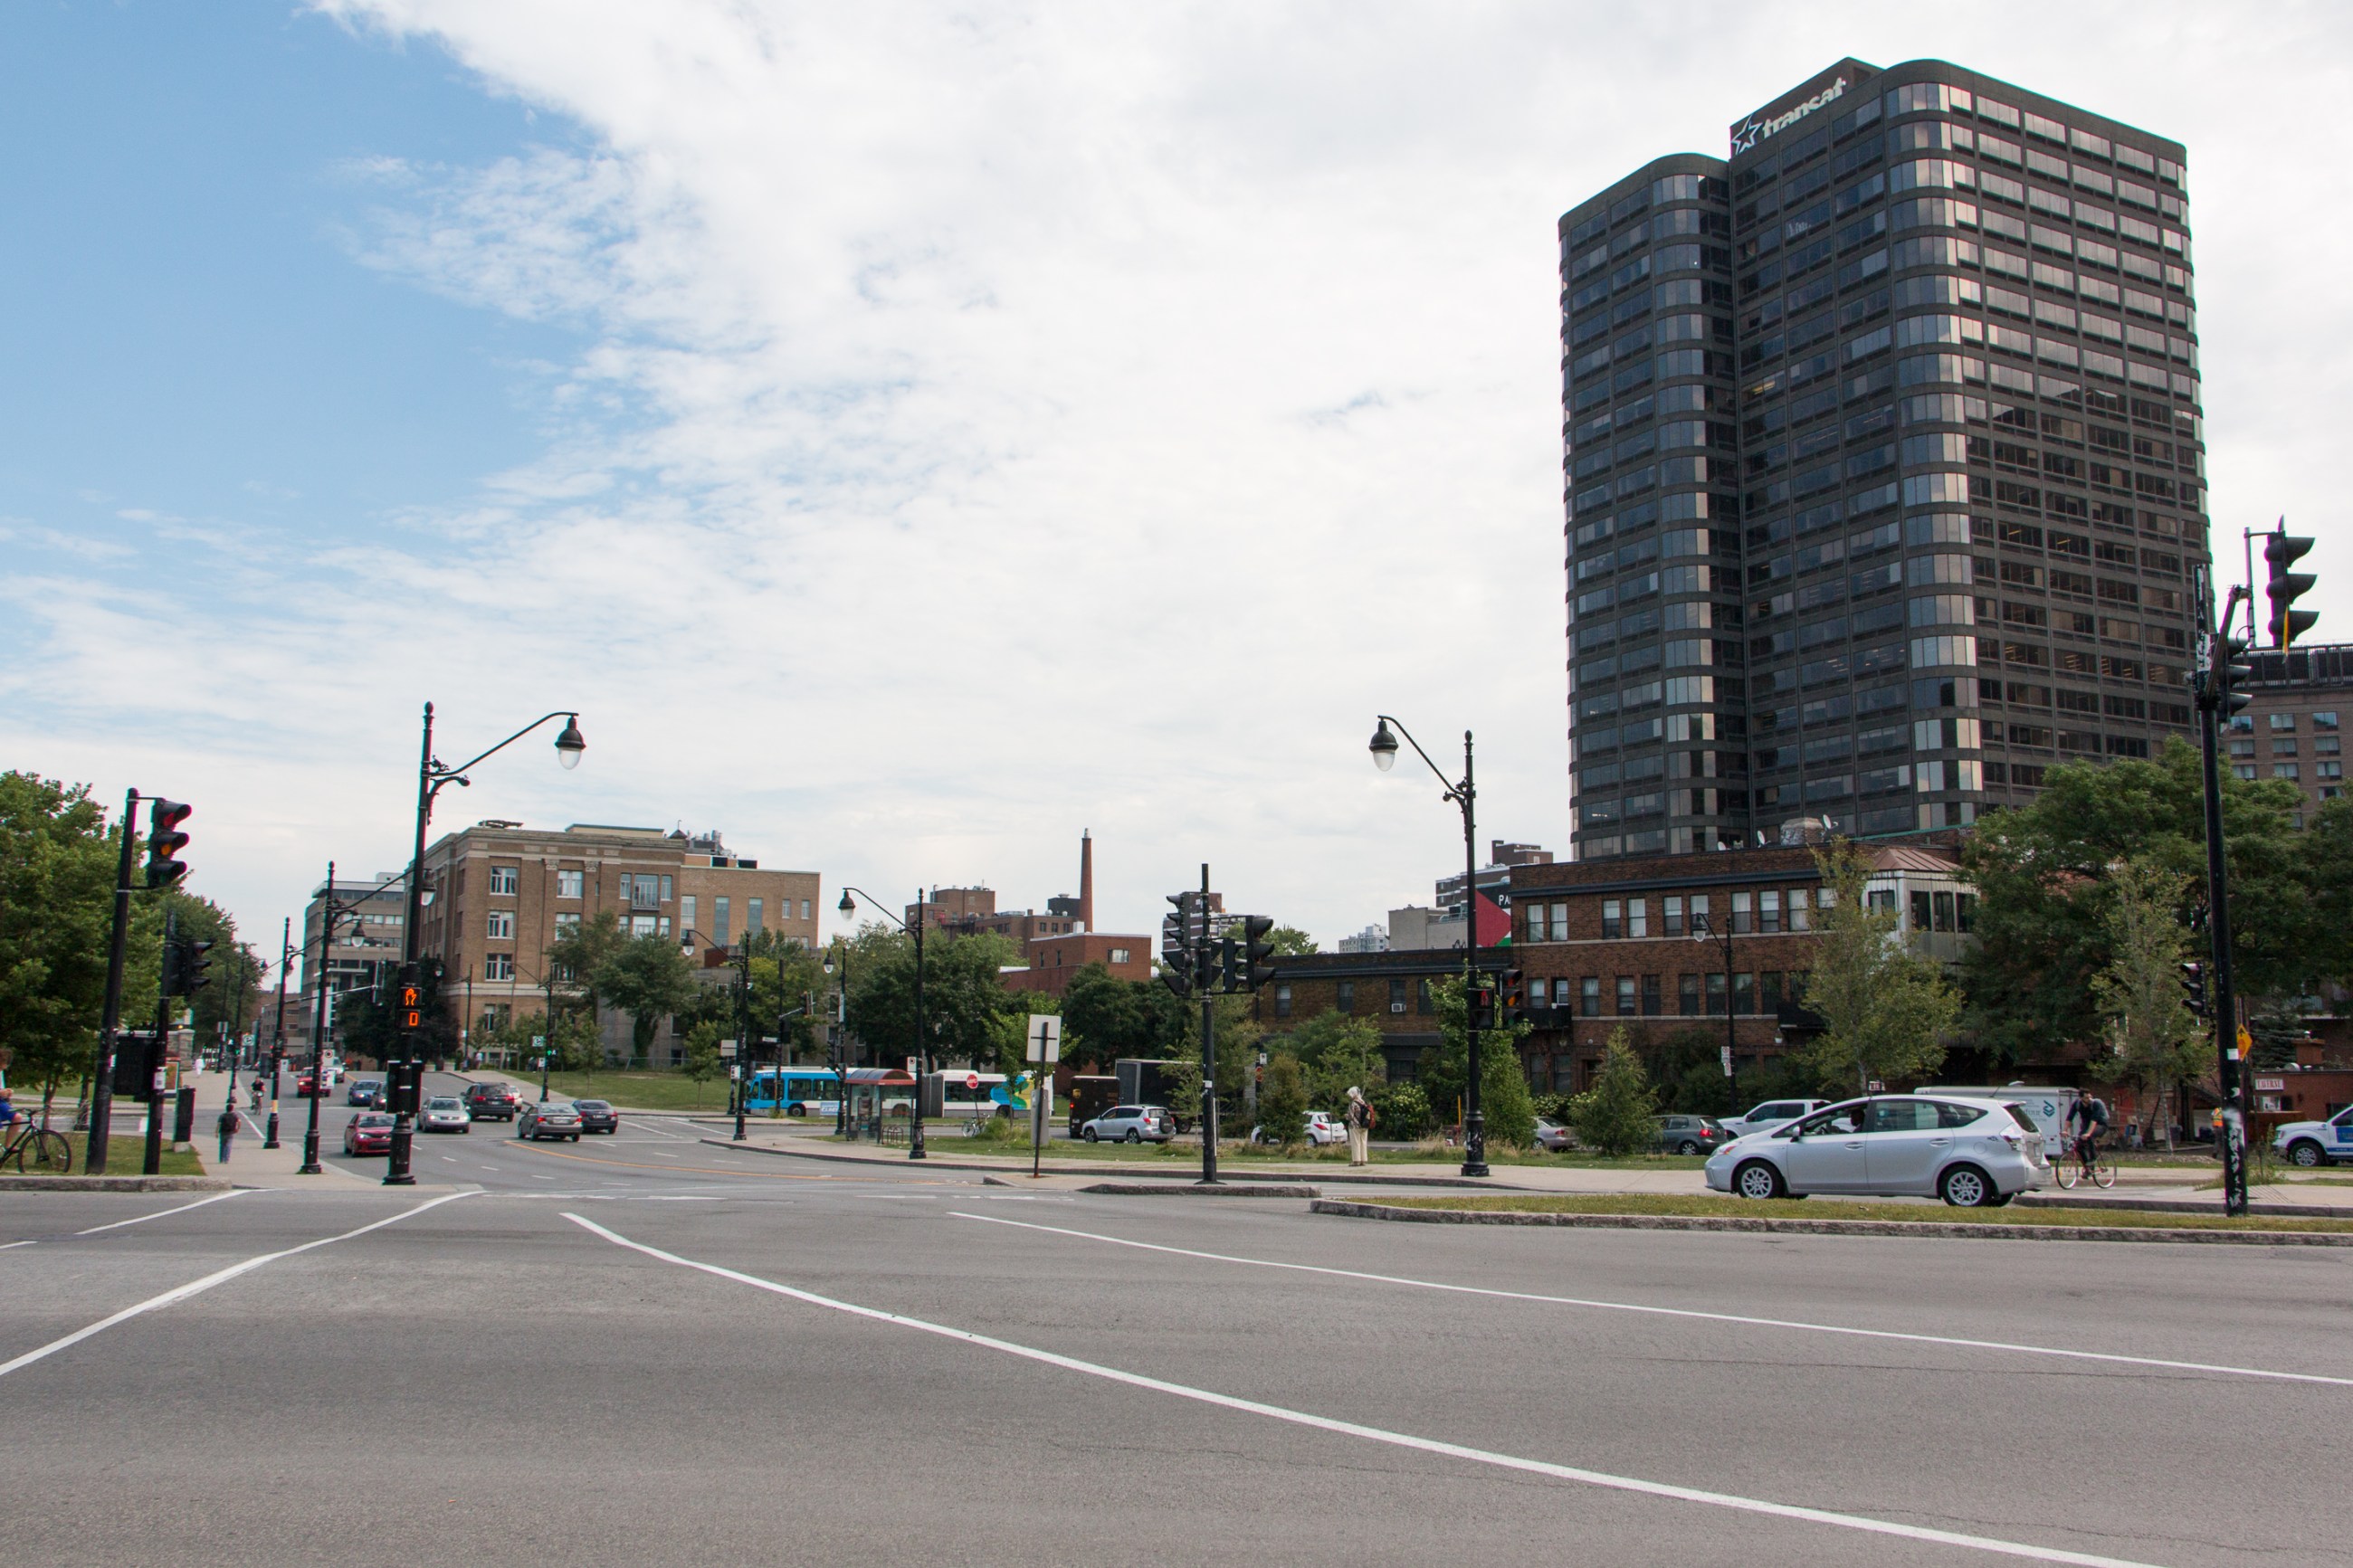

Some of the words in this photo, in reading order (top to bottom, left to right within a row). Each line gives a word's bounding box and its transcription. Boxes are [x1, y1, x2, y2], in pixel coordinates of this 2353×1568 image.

[1762, 76, 1847, 139] transat
[409, 1012, 419, 1027] 0
[2257, 1079, 2281, 1088] TAVERNE
